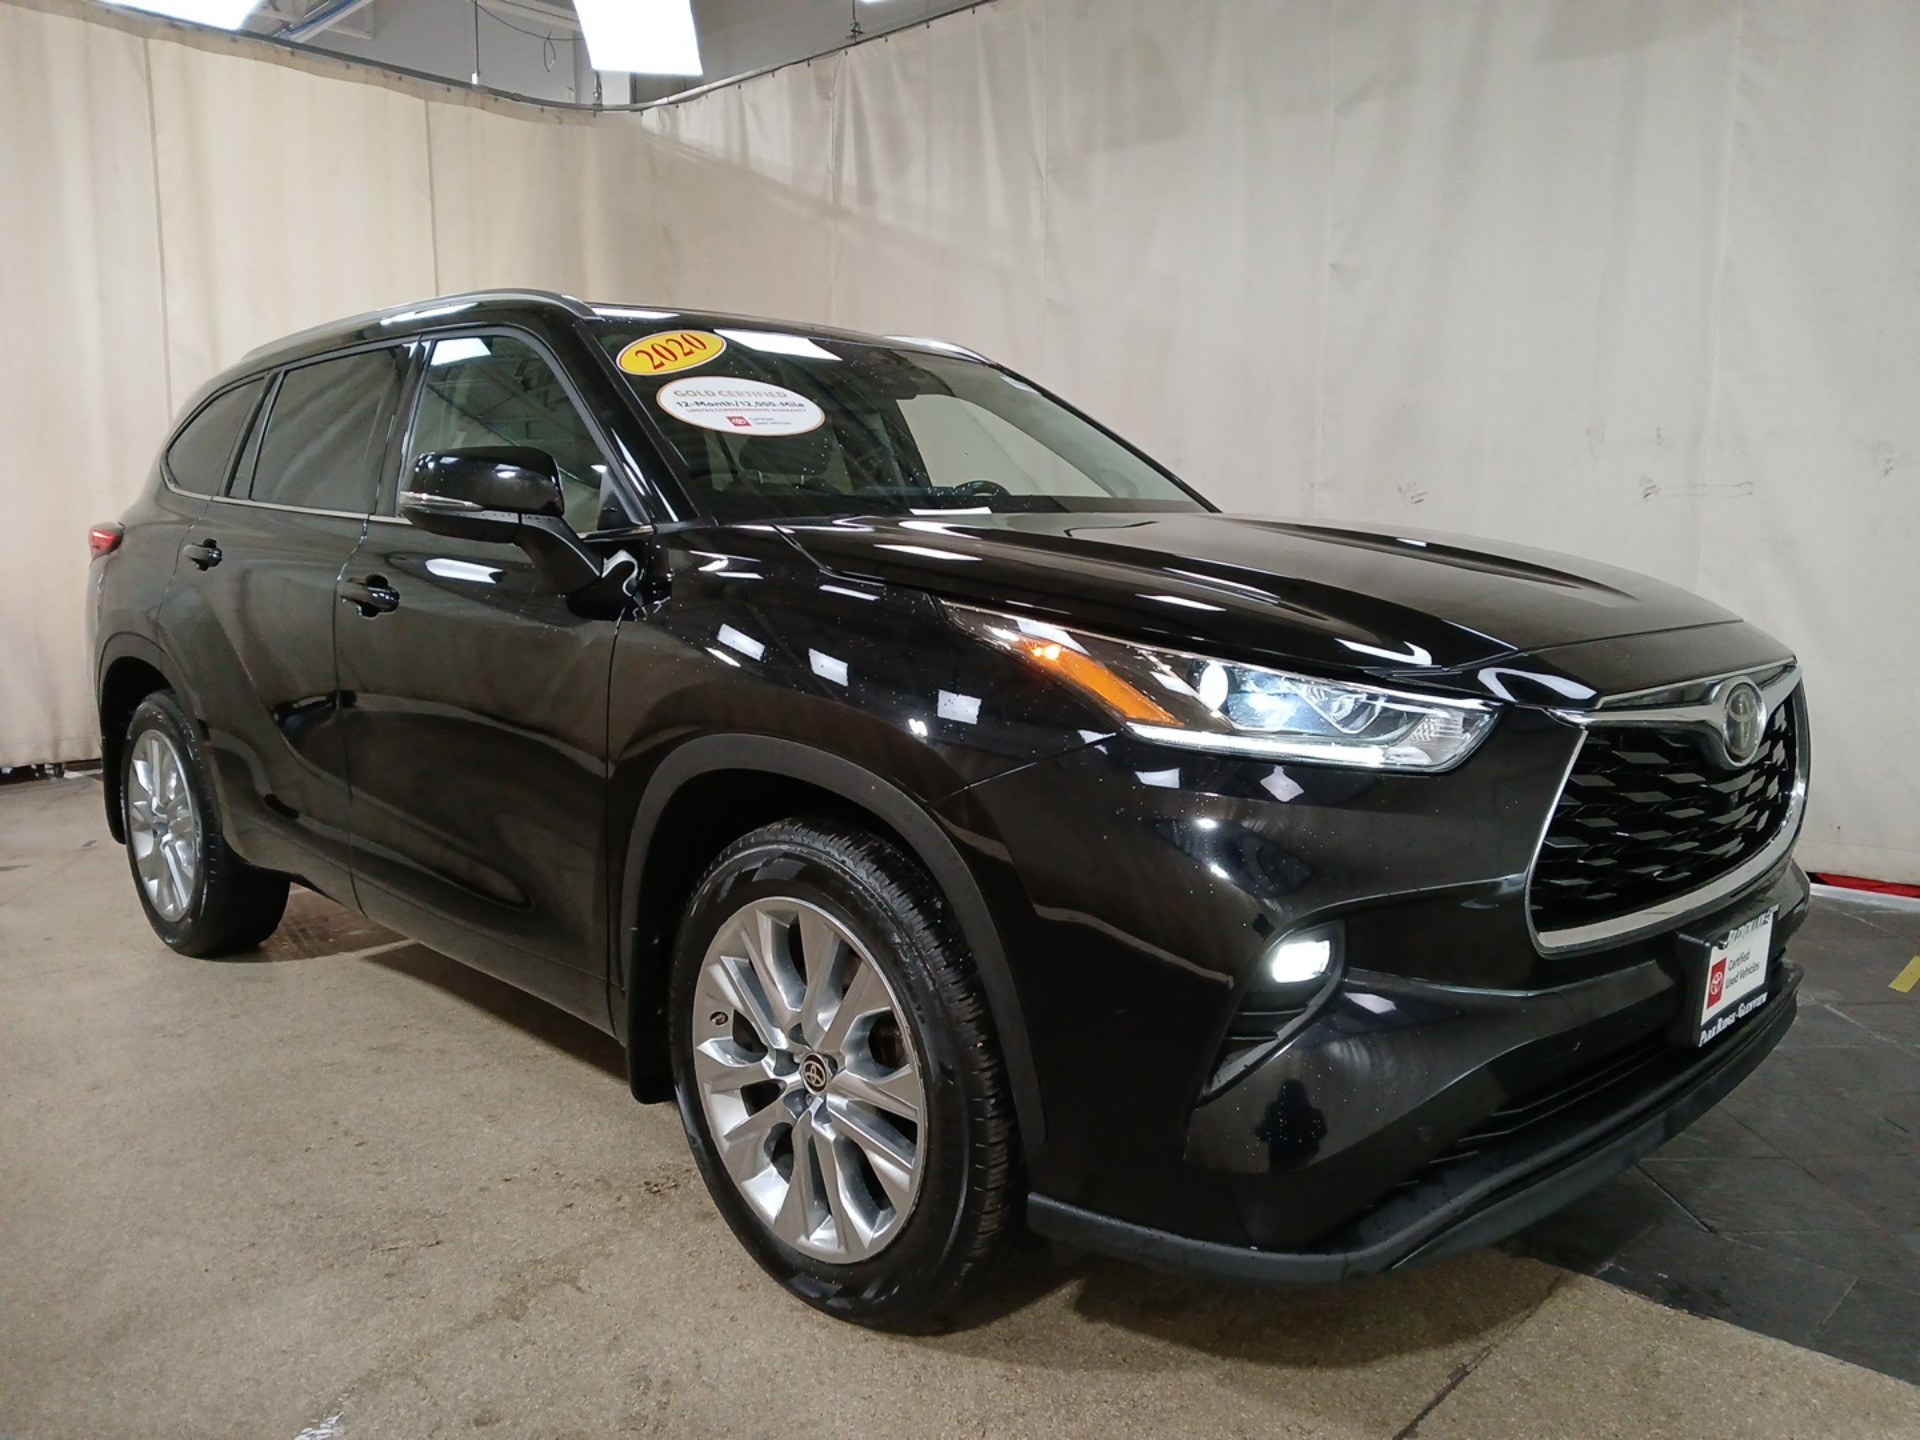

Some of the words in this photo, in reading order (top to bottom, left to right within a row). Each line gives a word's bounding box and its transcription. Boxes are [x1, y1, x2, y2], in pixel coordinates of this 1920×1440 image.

[635, 333, 708, 370] 2020
[673, 389, 716, 398] GOLD
[719, 390, 788, 398] CERTIFIED
[1727, 950, 1751, 971] Certified
[1739, 961, 1760, 981] Vehicles
